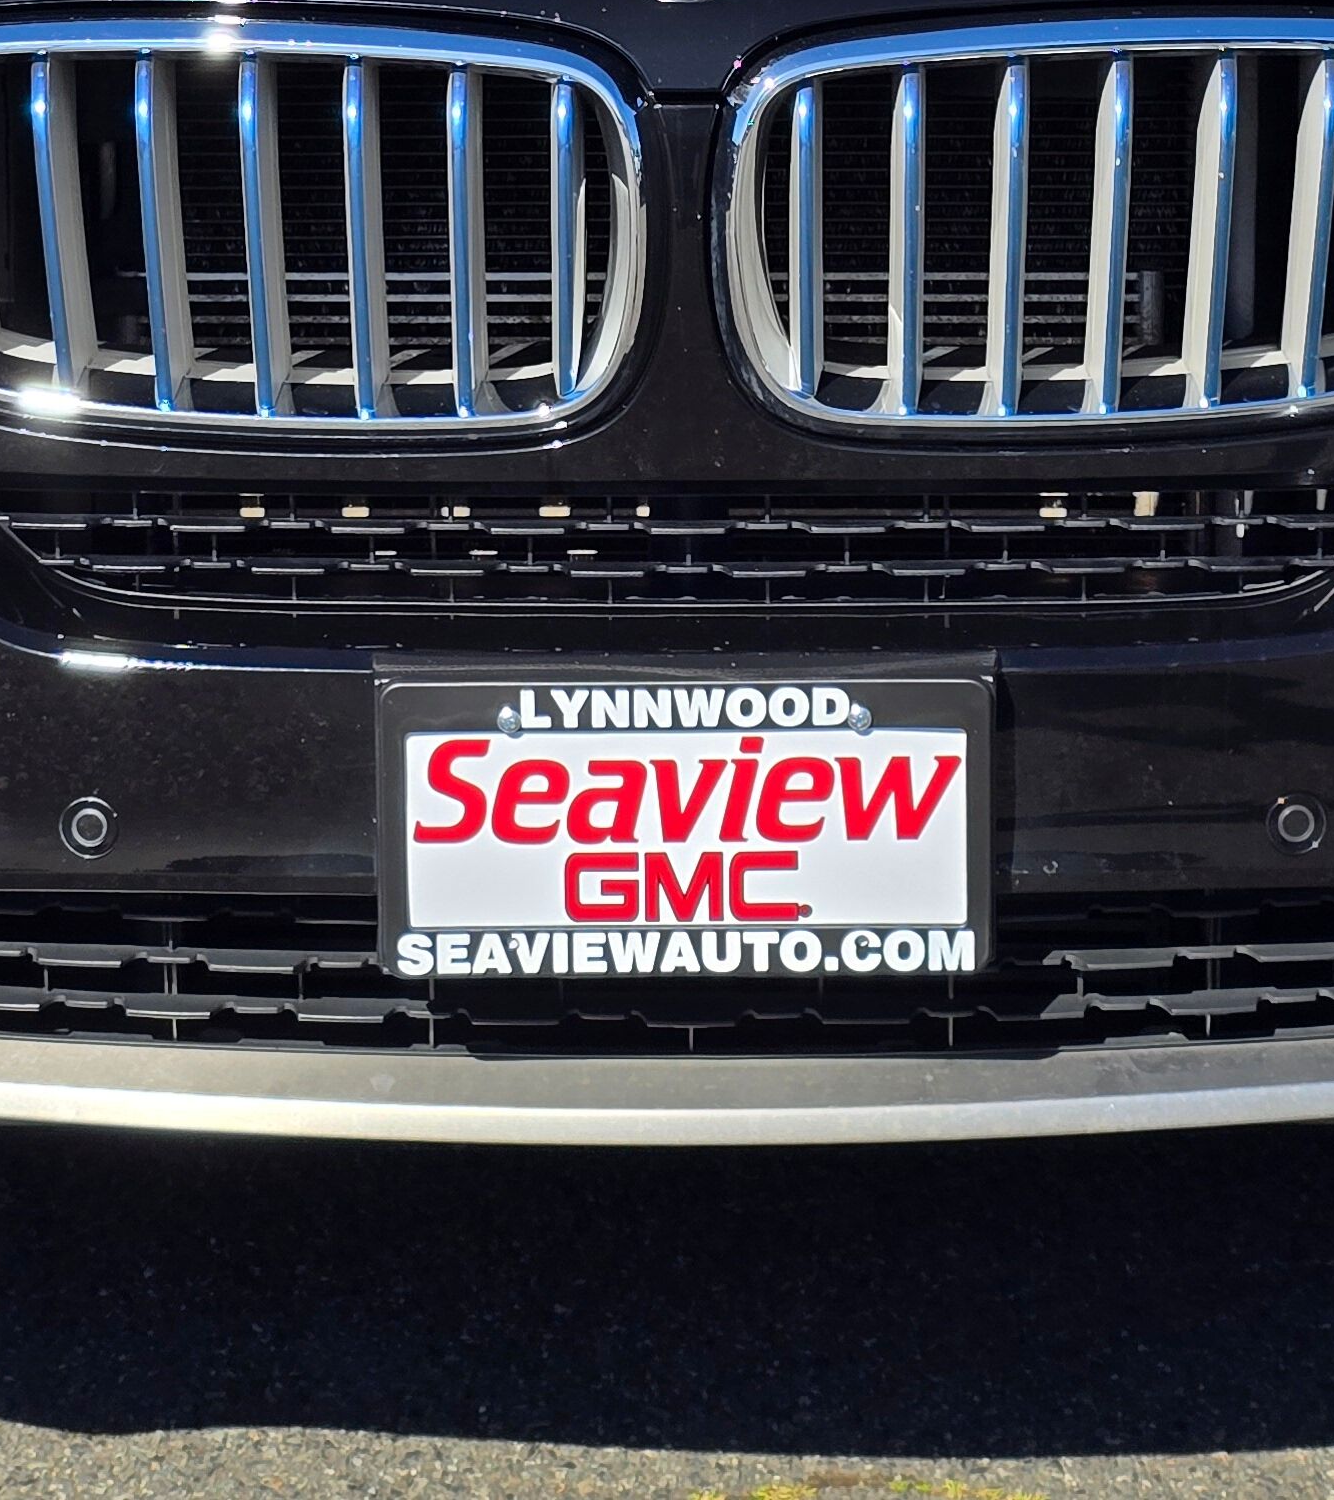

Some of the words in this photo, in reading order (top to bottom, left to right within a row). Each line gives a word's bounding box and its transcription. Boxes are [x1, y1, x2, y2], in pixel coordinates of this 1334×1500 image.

[519, 688, 851, 729] LYNNWOOD
[413, 736, 962, 844] Seaview
[397, 930, 975, 975] SEAVIEWAUTO.COM
